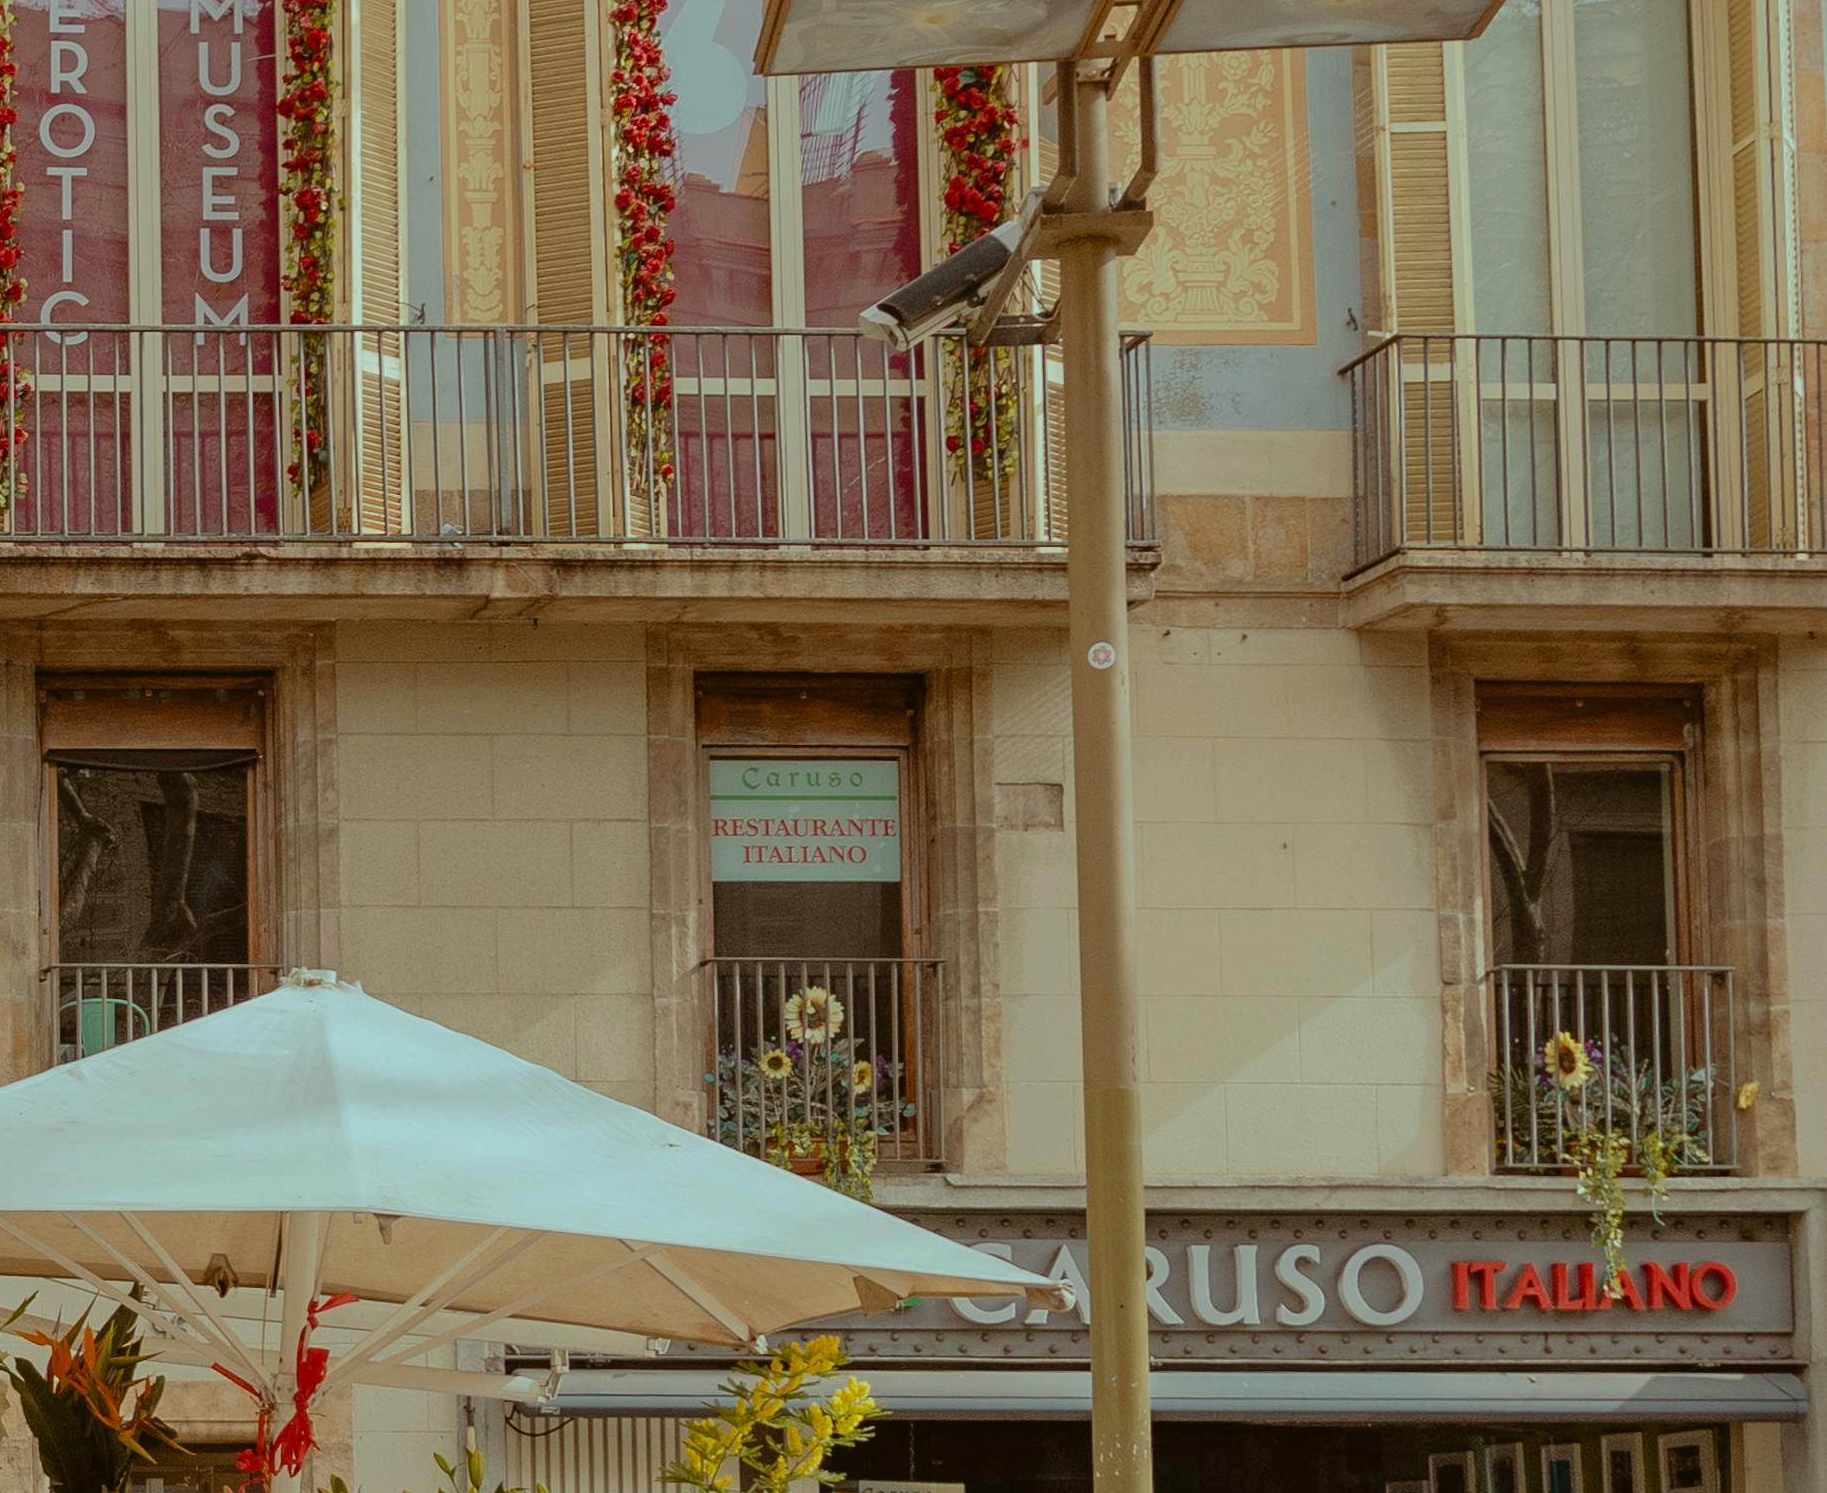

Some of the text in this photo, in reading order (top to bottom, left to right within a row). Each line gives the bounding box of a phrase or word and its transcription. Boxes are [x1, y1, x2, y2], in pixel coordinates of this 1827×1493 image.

[740, 766, 865, 791] Caruso
[712, 818, 896, 839] RESTAURANTE
[742, 844, 868, 865] ITALIANO
[1451, 1260, 1737, 1311] ITALIANO
